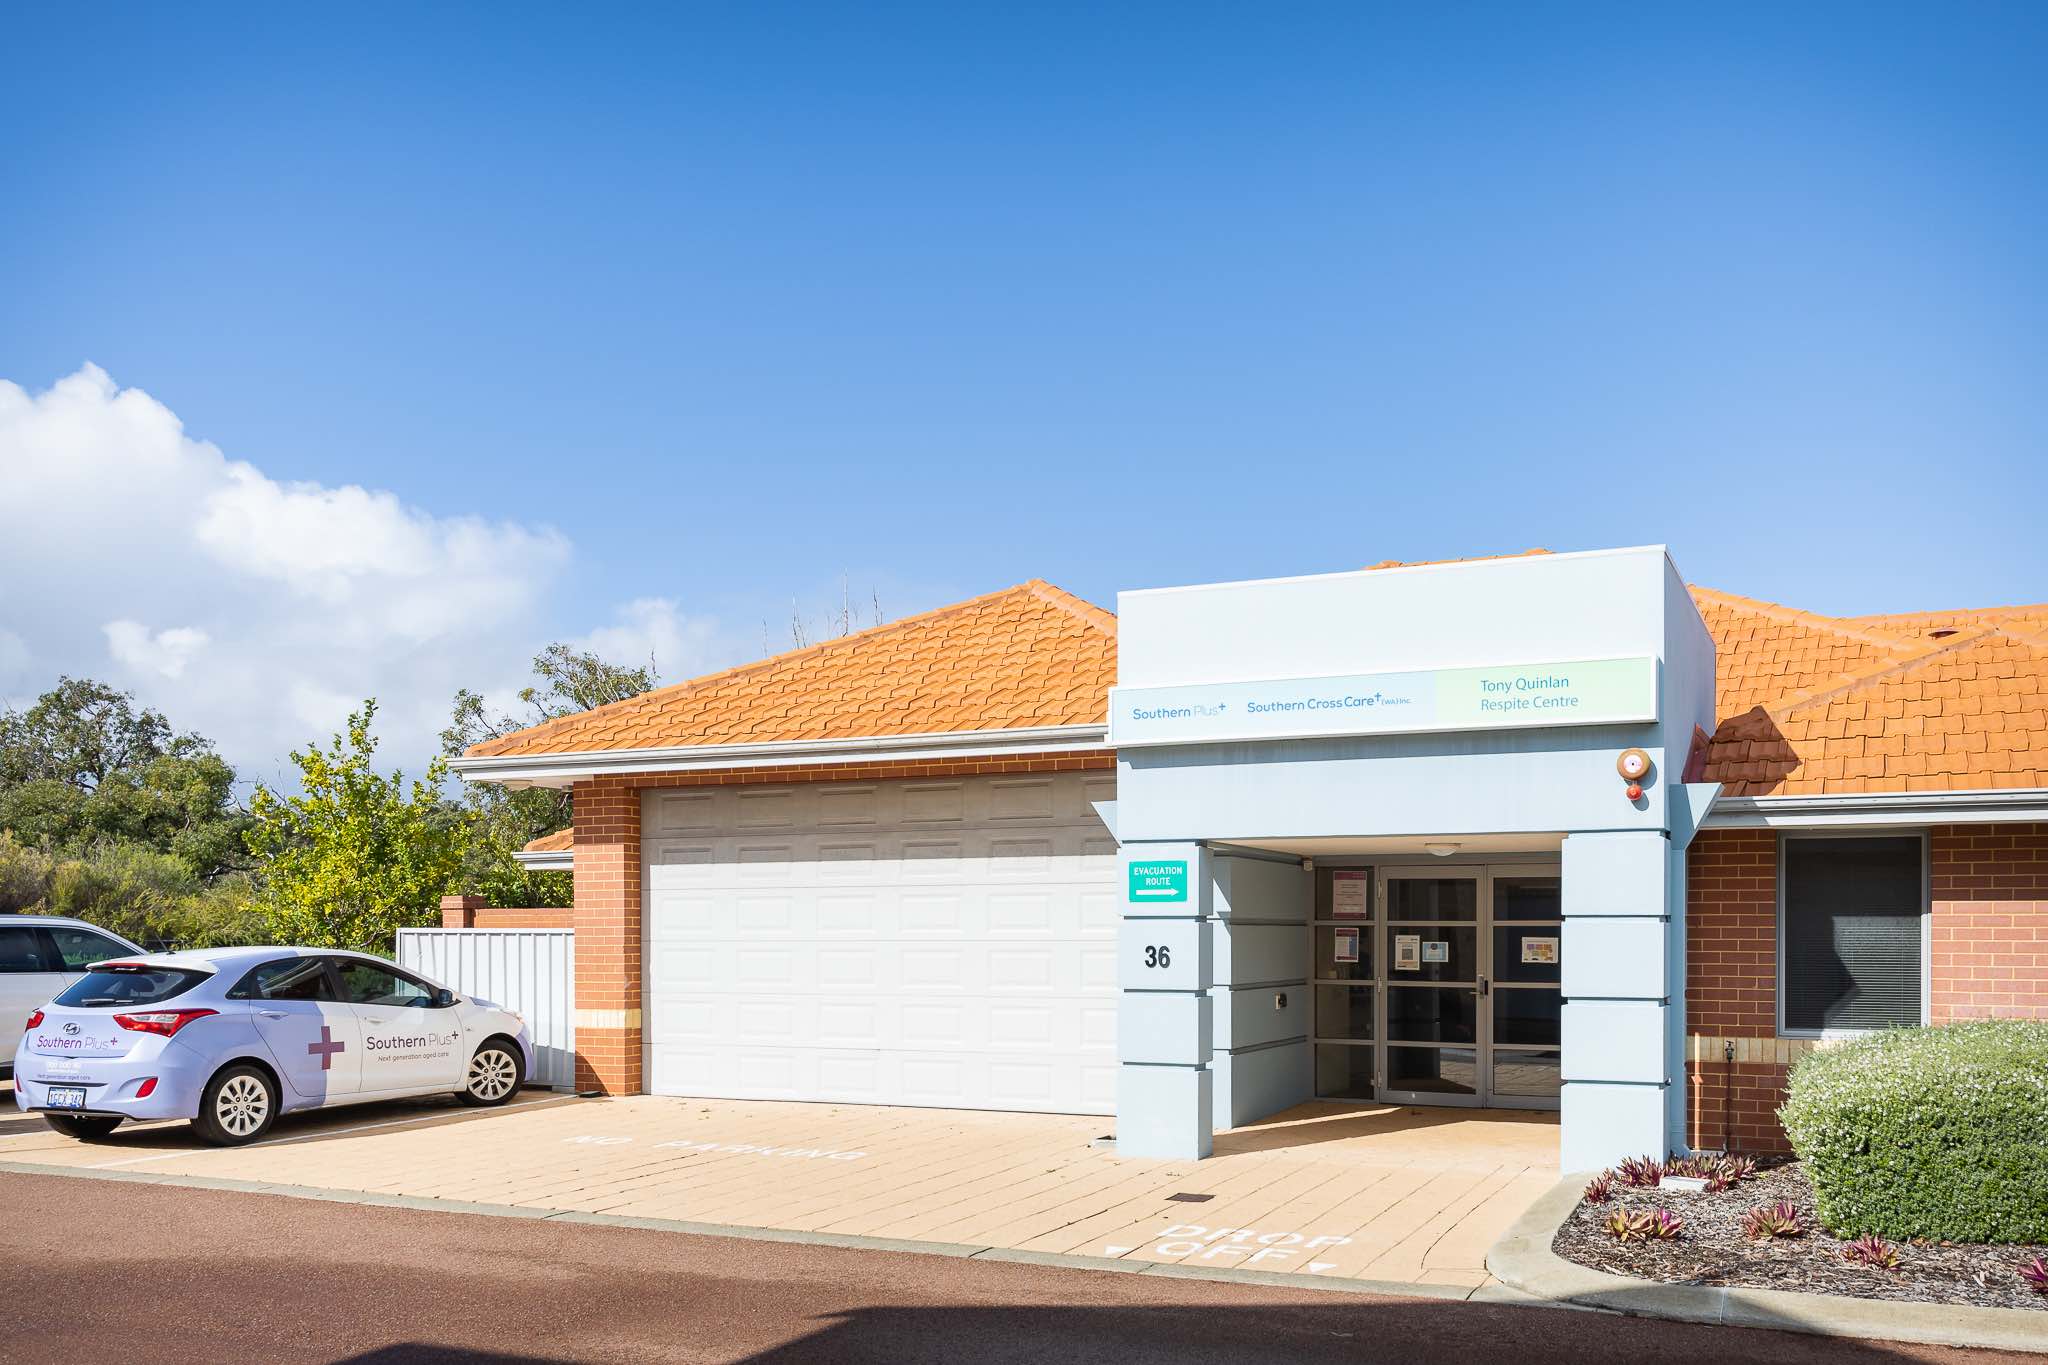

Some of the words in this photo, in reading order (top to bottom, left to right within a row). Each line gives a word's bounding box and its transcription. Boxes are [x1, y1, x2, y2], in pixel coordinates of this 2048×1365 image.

[1480, 679, 1512, 694] Tony
[1515, 676, 1569, 691] Quinlan
[1247, 700, 1305, 713] Southern
[1307, 697, 1343, 710] Cross
[1481, 697, 1529, 712] Respite
[1533, 695, 1579, 709] Centre
[1132, 707, 1191, 720] Southern
[1133, 866, 1183, 876] EVACUATION
[1145, 877, 1171, 886] ROUTE
[1144, 945, 1171, 969] 36
[37, 1035, 82, 1049] Southern
[366, 1036, 426, 1050] Southern
[377, 1054, 391, 1062] Next
[392, 1053, 422, 1063] generation
[423, 1052, 437, 1060] aged
[651, 1139, 870, 1160] PARKING
[1154, 1224, 1353, 1248] DROP
[1156, 1241, 1300, 1264] OFF
